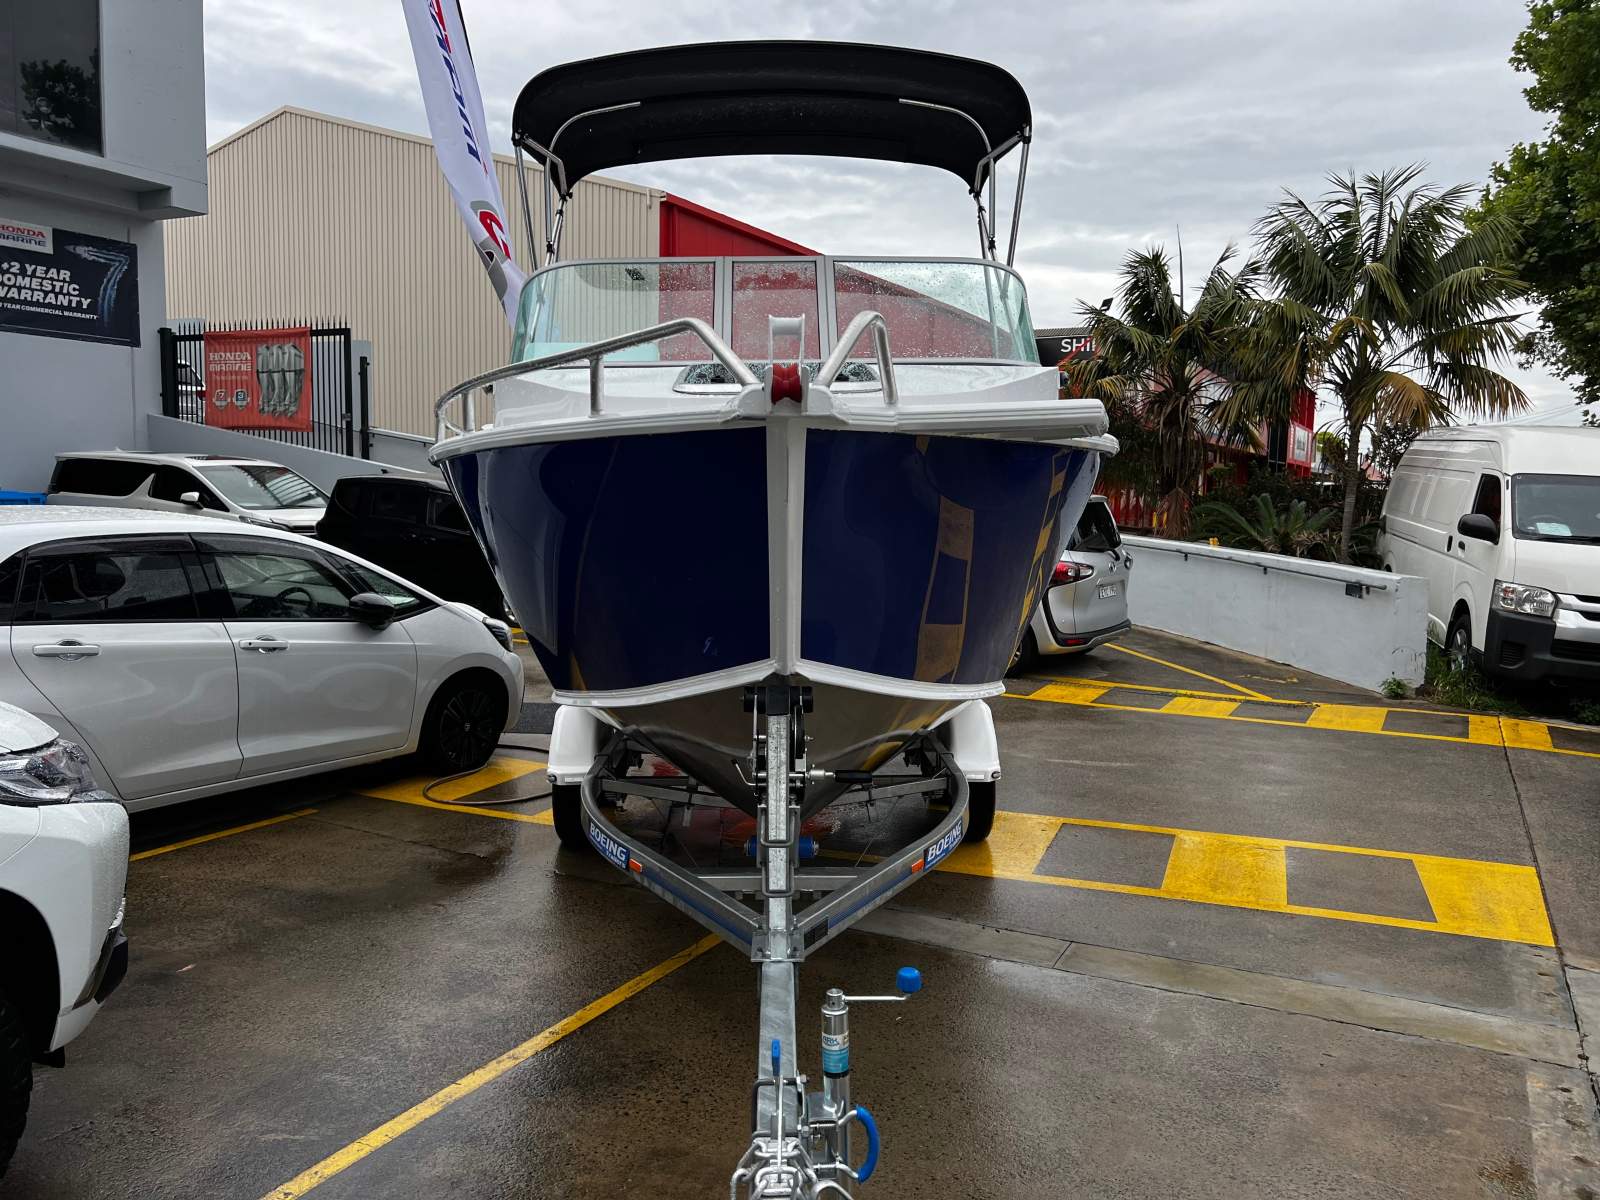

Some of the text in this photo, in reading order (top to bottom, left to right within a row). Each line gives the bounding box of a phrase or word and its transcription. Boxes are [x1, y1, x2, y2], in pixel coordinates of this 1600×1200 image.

[1, 261, 71, 282] +2 YEAR
[0, 273, 80, 296] OMESTIC
[21, 305, 63, 316] COMMERCIAL
[209, 352, 252, 361] HONDA
[590, 822, 627, 861] BOEING
[927, 819, 962, 861] BOEING
